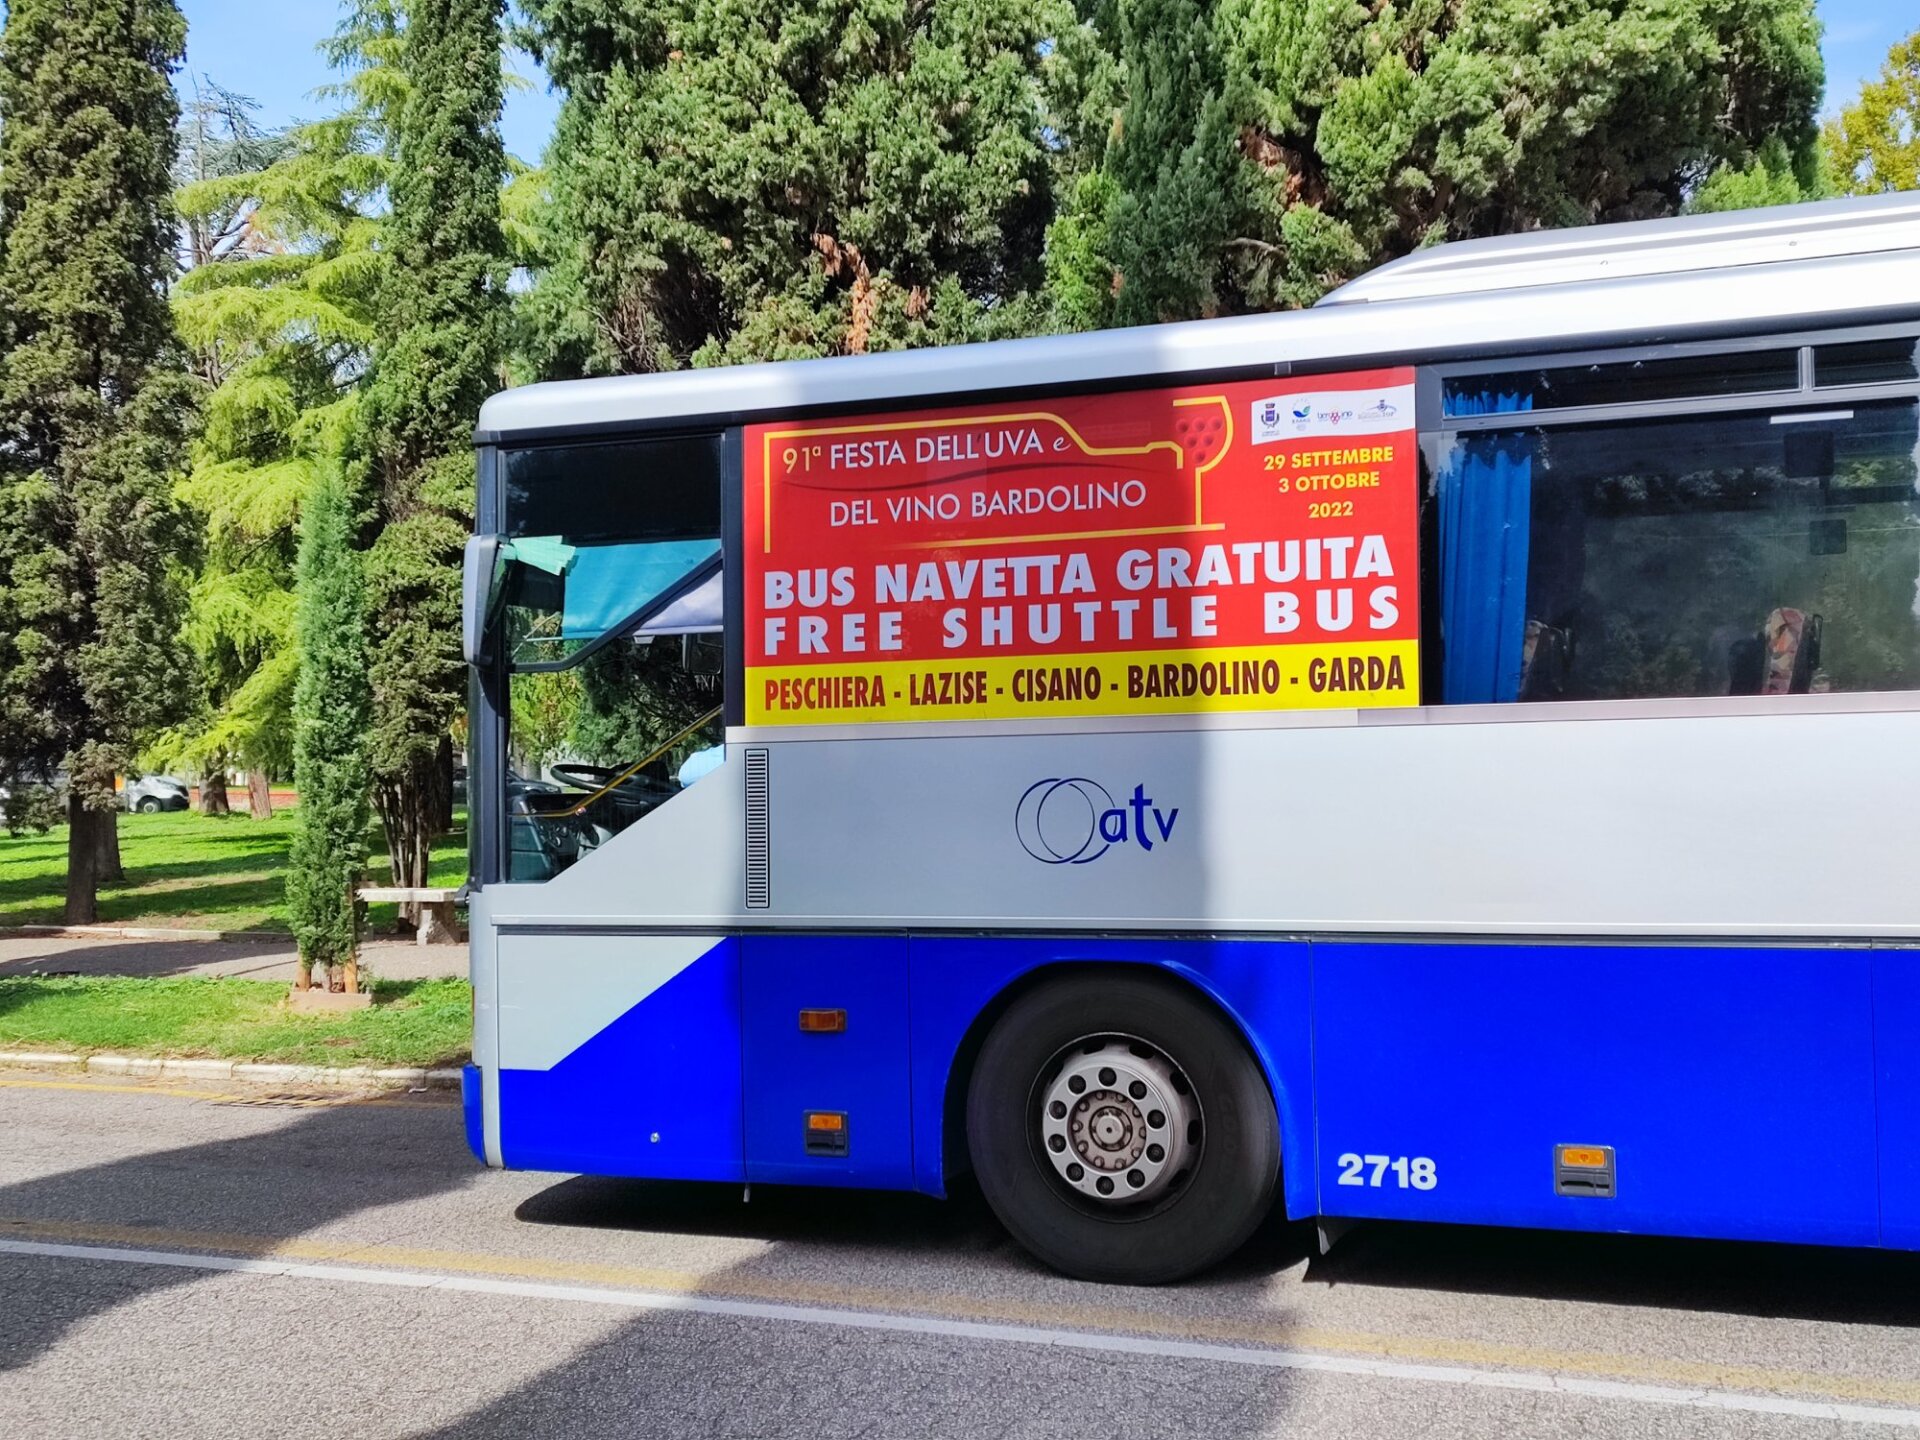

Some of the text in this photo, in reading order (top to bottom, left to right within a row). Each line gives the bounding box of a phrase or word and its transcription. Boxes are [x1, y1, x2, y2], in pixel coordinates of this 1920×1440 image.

[830, 440, 907, 470] FESTA
[916, 428, 1043, 463] DELL'UVA
[1263, 446, 1394, 471] 29 SETTEMBRE
[830, 479, 1147, 527] DEL VINO BARDOLINO
[1278, 471, 1380, 493] 3 OTTOBRE
[1308, 501, 1354, 519] 2022
[764, 534, 1395, 610] BUS NAVETTA GRATUITA
[764, 585, 1399, 656] FREE SHUTTLE BUS
[765, 675, 886, 711] PESCHIERA
[909, 670, 988, 706] LAZISE
[1012, 666, 1101, 703] CISANO
[1127, 659, 1280, 699] BARDOLINO
[1308, 655, 1406, 694] GARDA
[1099, 783, 1179, 852] atv
[1337, 1153, 1438, 1191] 2718
